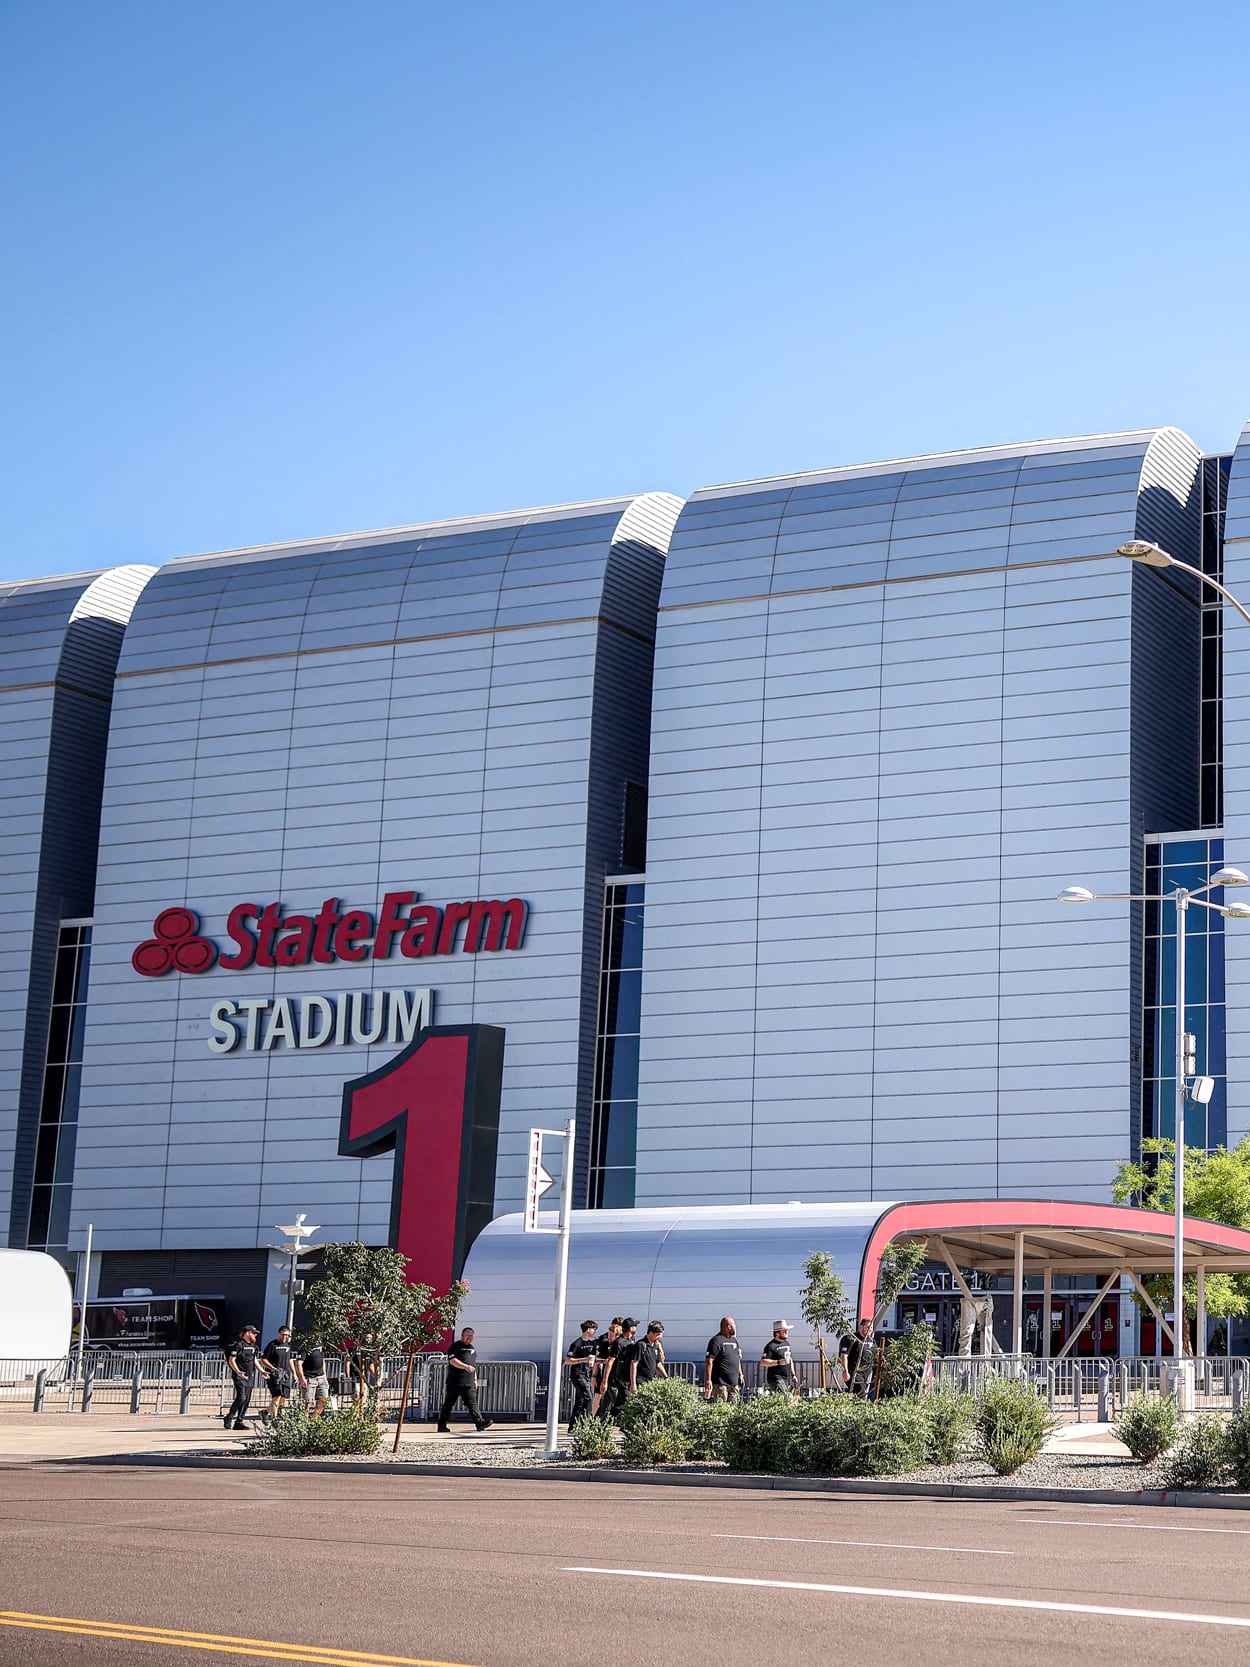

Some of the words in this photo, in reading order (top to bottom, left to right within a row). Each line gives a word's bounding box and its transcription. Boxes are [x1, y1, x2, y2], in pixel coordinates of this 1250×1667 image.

[207, 987, 434, 1053] STADIUM
[338, 1024, 505, 1350] 1
[905, 1272, 963, 1290] GATE
[970, 1272, 981, 1290] 1
